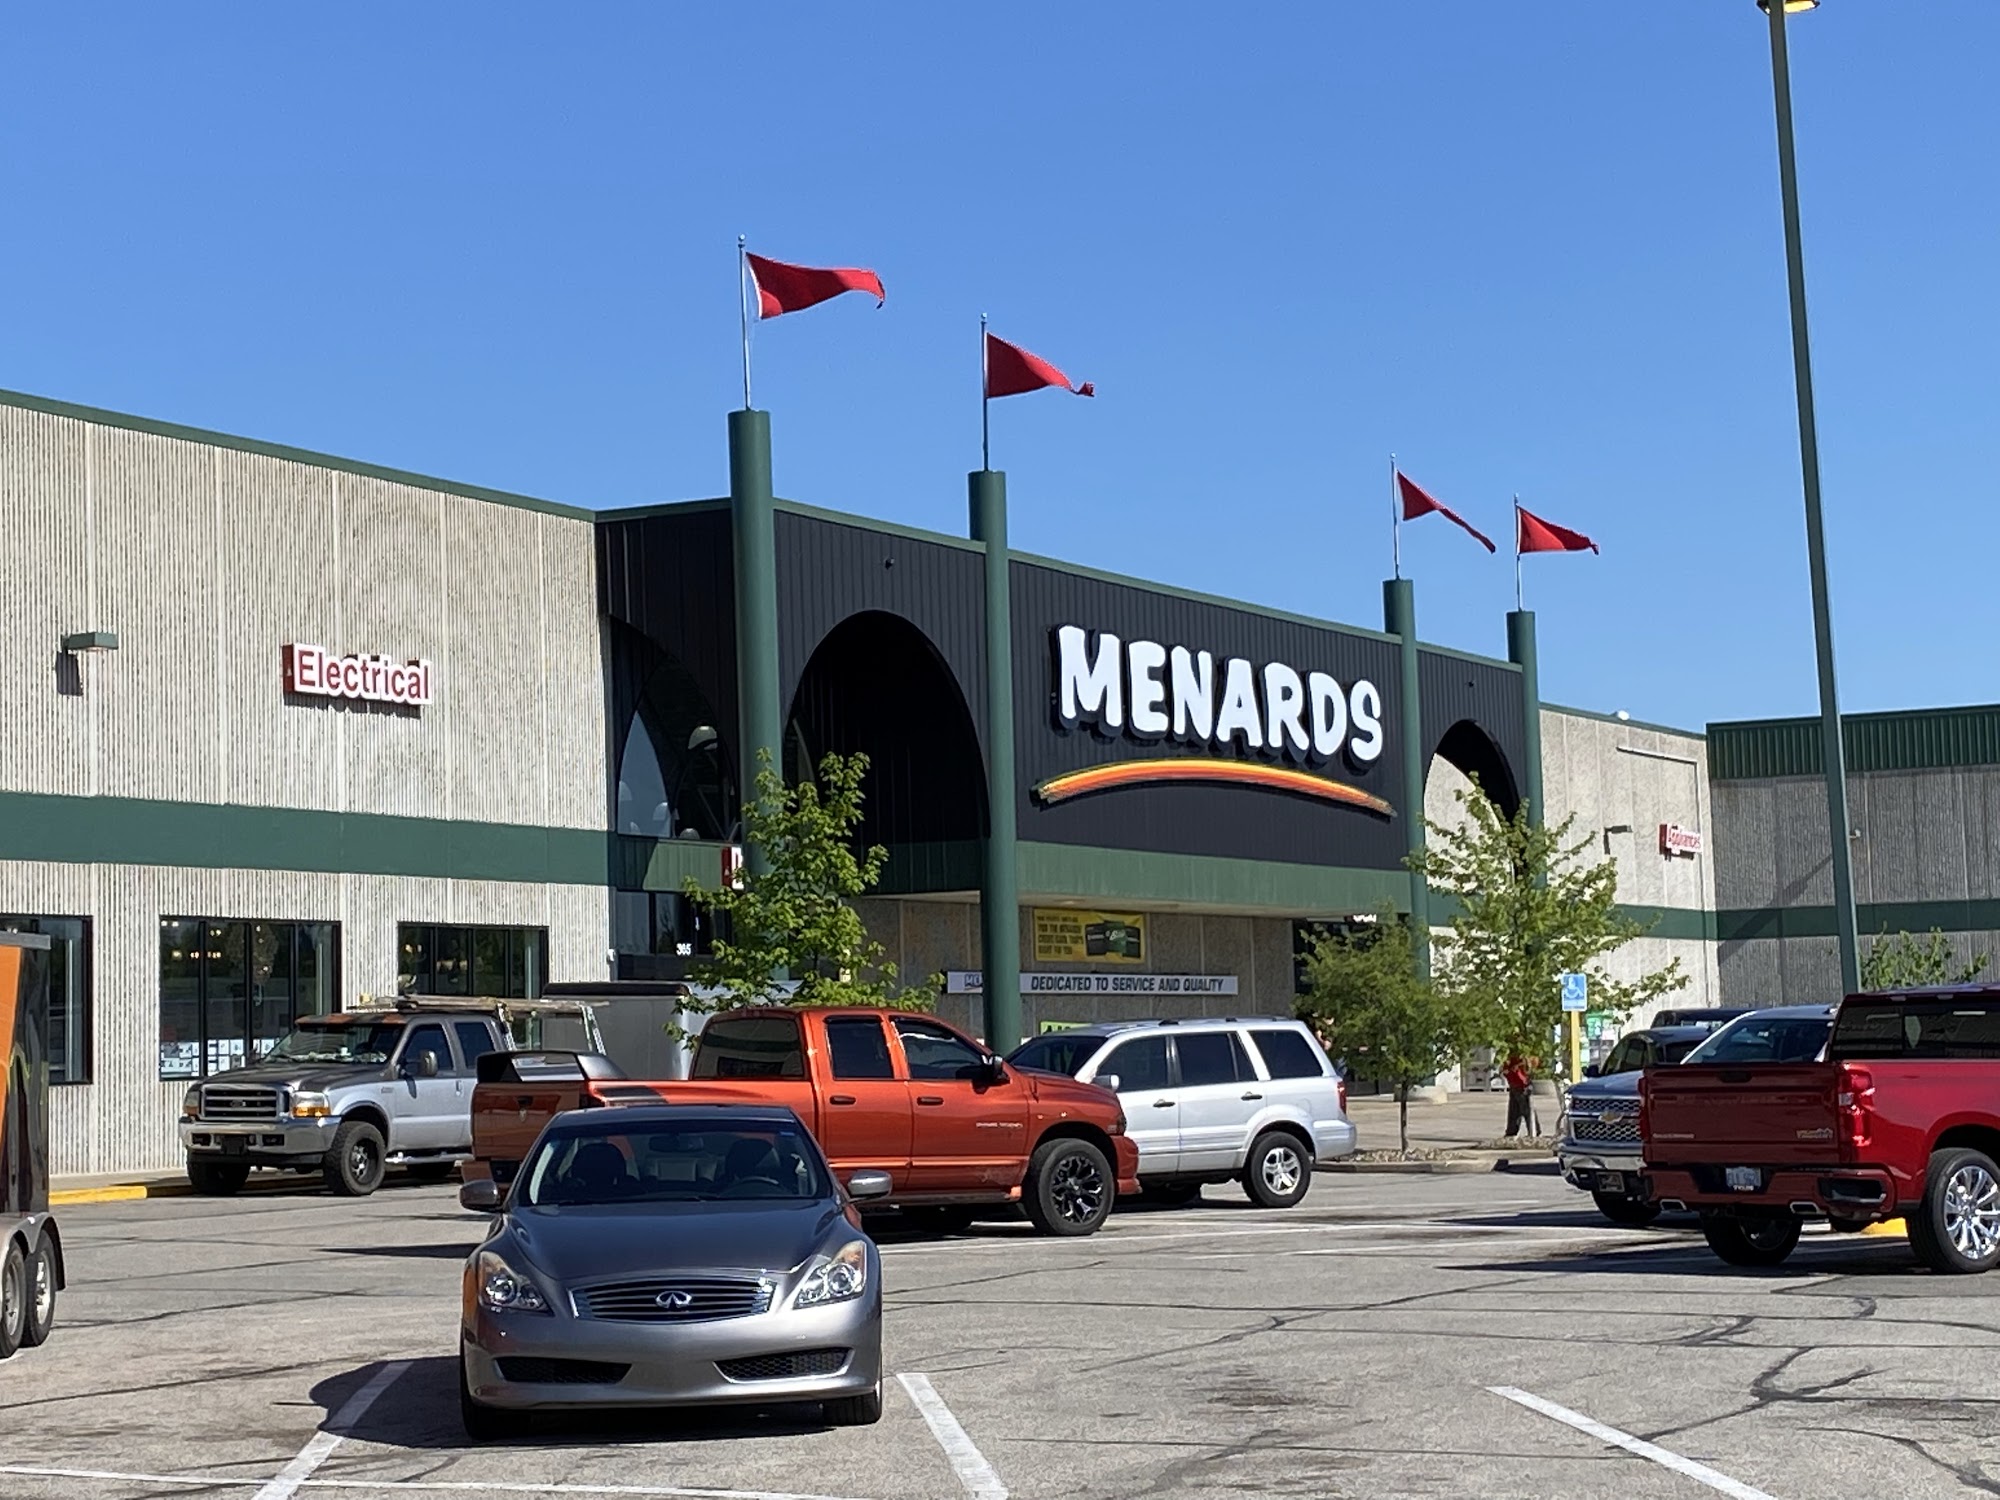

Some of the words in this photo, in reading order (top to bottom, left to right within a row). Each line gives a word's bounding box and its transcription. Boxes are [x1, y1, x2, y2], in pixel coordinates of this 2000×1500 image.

[298, 649, 429, 700] Electrical
[1058, 624, 1383, 761] MENARDS
[1031, 975, 1092, 992] DEDICATED
[1095, 977, 1109, 992] TO
[1112, 977, 1155, 992] SERVICE
[1158, 978, 1181, 992] AND
[1183, 978, 1224, 993] QUALITY
